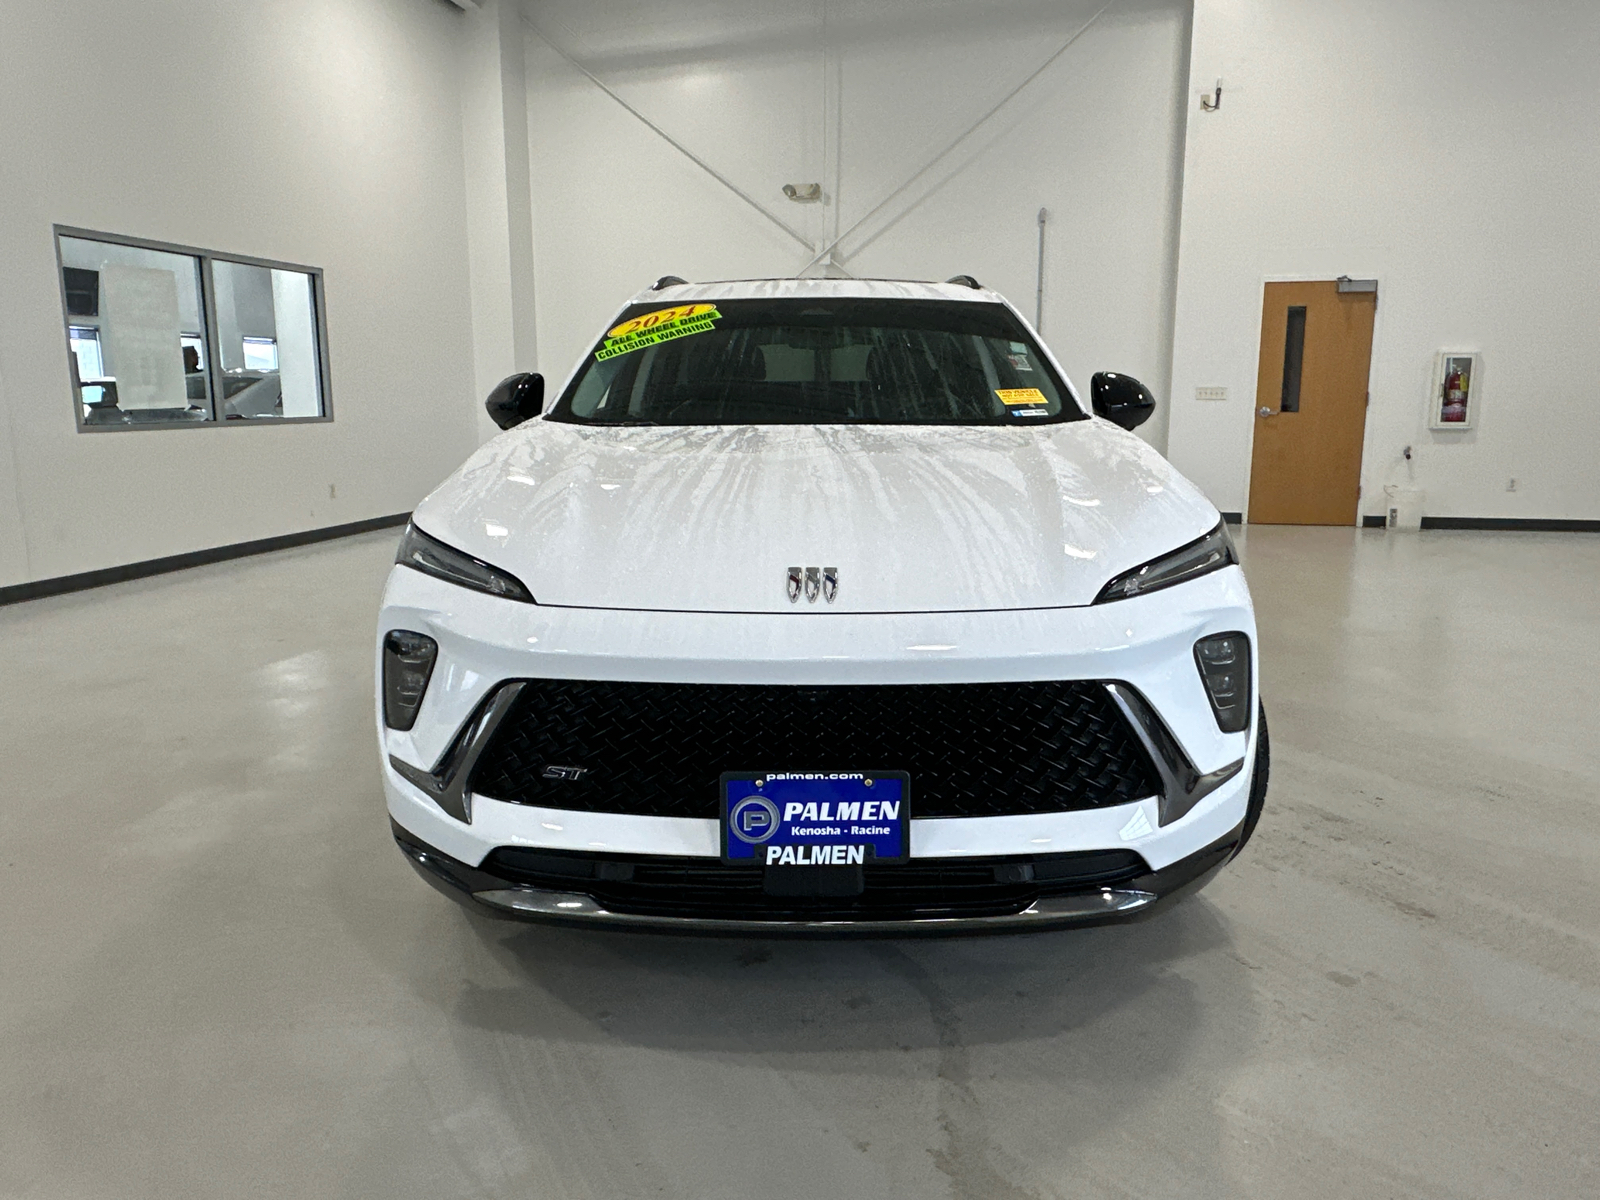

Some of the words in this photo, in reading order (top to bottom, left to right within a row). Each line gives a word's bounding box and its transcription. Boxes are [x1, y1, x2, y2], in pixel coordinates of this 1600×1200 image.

[625, 305, 696, 335] 2024
[636, 320, 680, 338] WHEEL
[680, 311, 718, 326] DRIVE
[597, 337, 656, 360] COLLISION
[657, 322, 713, 340] WARNING
[542, 765, 588, 780] ST
[766, 772, 864, 782] palmen.com
[783, 801, 901, 821] PALMEN
[791, 826, 841, 836] Kenosha
[851, 825, 891, 835] Racine
[766, 845, 865, 865] PALMEN
